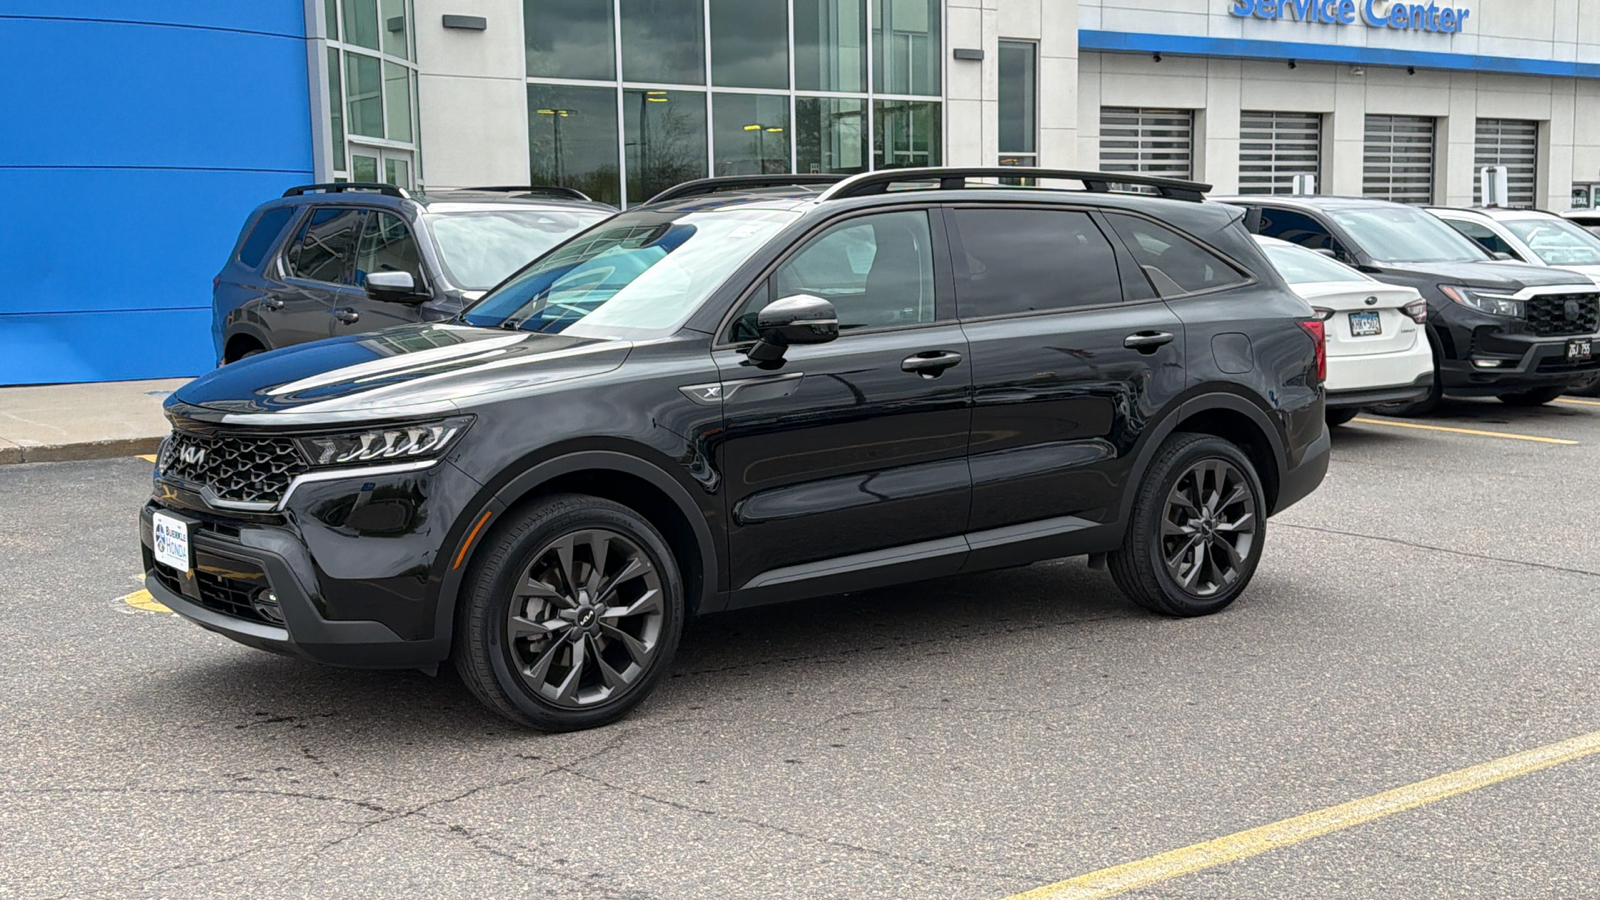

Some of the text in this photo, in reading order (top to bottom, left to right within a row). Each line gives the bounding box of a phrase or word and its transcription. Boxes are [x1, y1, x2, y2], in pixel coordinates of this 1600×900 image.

[1231, 0, 1470, 33] Service Center
[166, 537, 187, 558] HONDA
